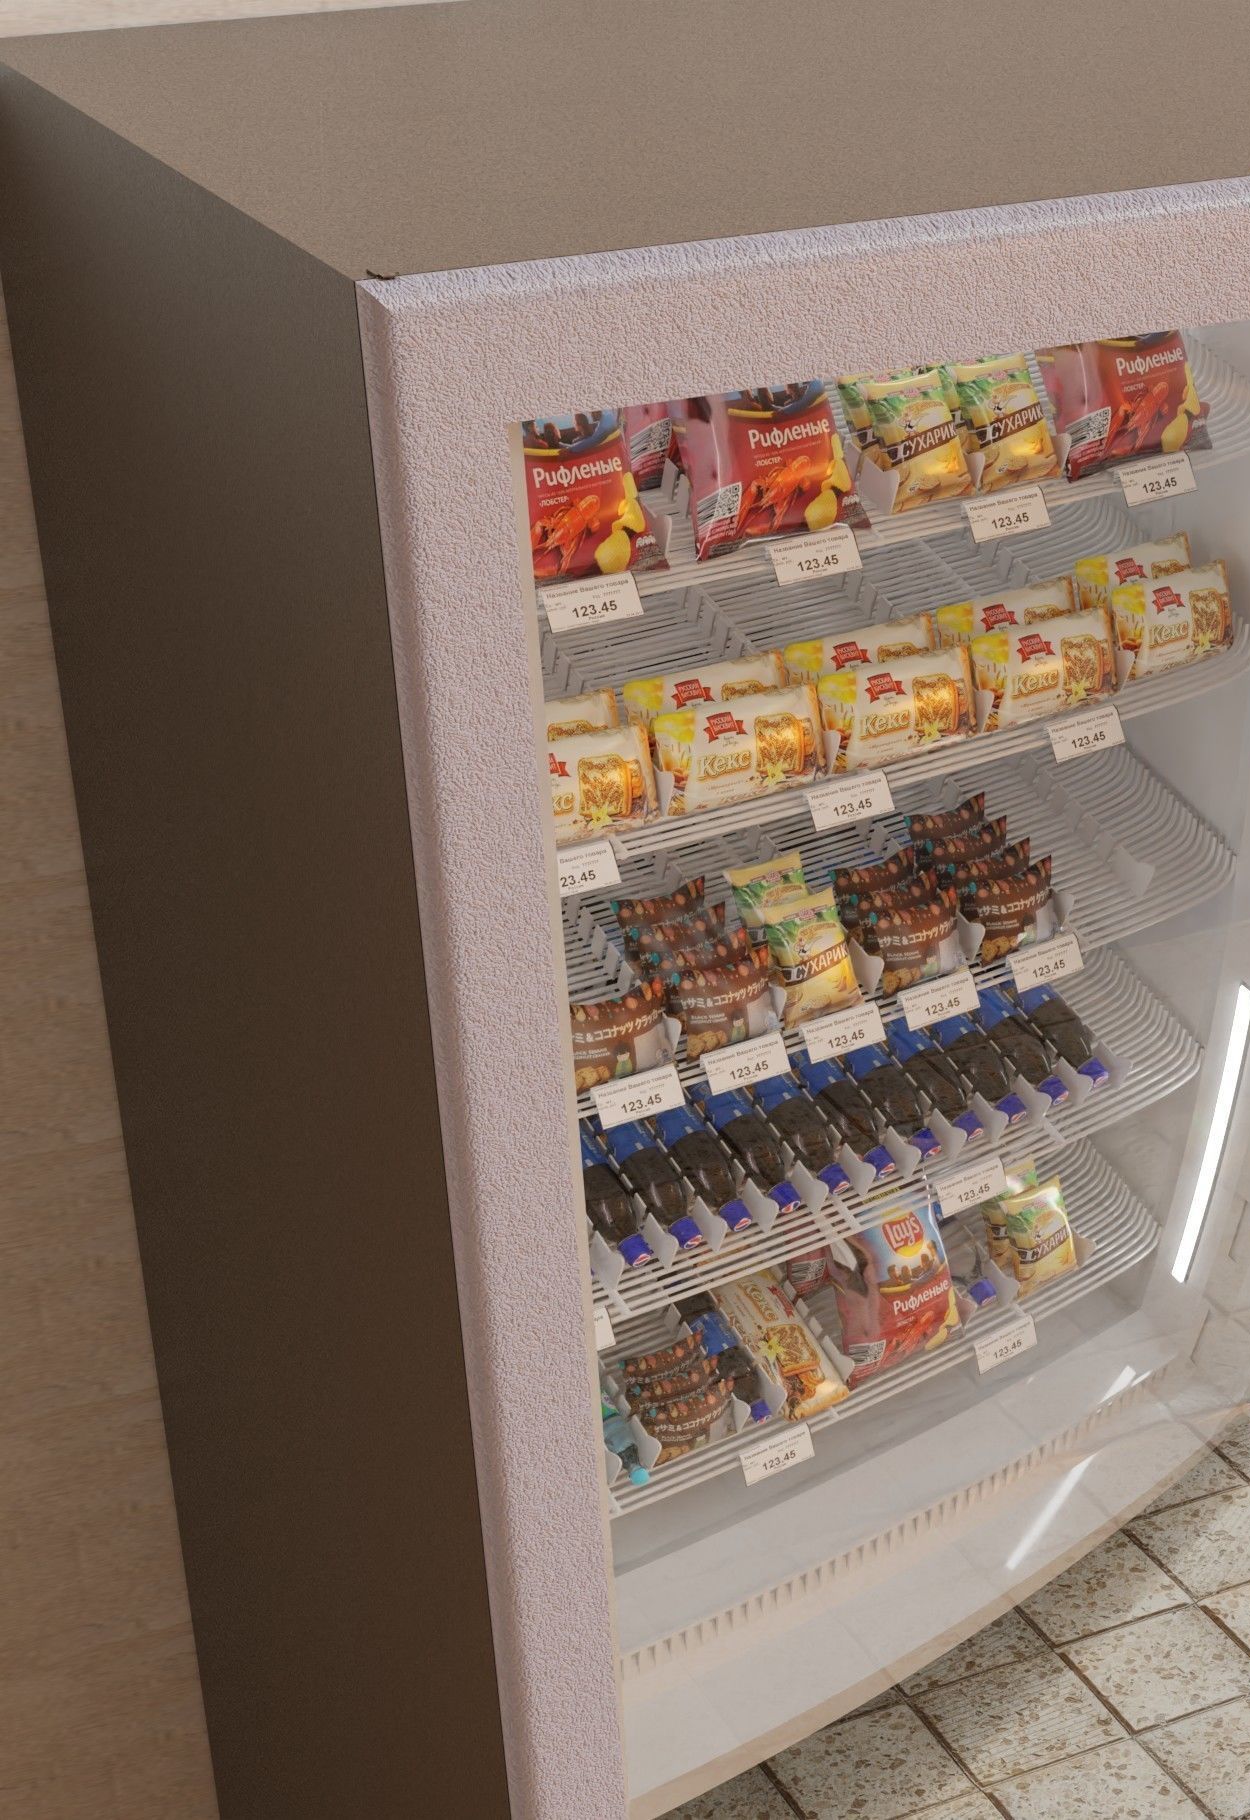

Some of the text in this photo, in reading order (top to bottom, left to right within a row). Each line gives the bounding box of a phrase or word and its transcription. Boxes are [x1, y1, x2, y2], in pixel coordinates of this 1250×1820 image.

[1116, 347, 1184, 376] Рифленые
[748, 418, 831, 450] Рифленые
[533, 456, 623, 489] Рифленые
[1143, 477, 1177, 494] 123.45
[991, 512, 1029, 531] 123.45
[797, 554, 839, 572] 123.45
[572, 599, 618, 619] 123.45
[1149, 621, 1189, 648] Кекс
[1012, 669, 1059, 699] Кекс
[860, 709, 911, 741] Кекс
[1071, 731, 1106, 750] 123.45
[698, 750, 752, 781] Кекс
[833, 798, 872, 817] 123.45
[1033, 960, 1066, 978] 123.45
[925, 997, 960, 1016] 123.45
[828, 1029, 865, 1049] 123.45
[730, 1061, 769, 1080] 123.45
[621, 1093, 662, 1114] 123.45
[958, 1183, 991, 1203] 123.45
[884, 1214, 921, 1249] Lay's
[893, 1279, 950, 1316] Рифленые
[993, 1339, 1022, 1359] 123.45
[762, 1450, 796, 1472] 123.45
